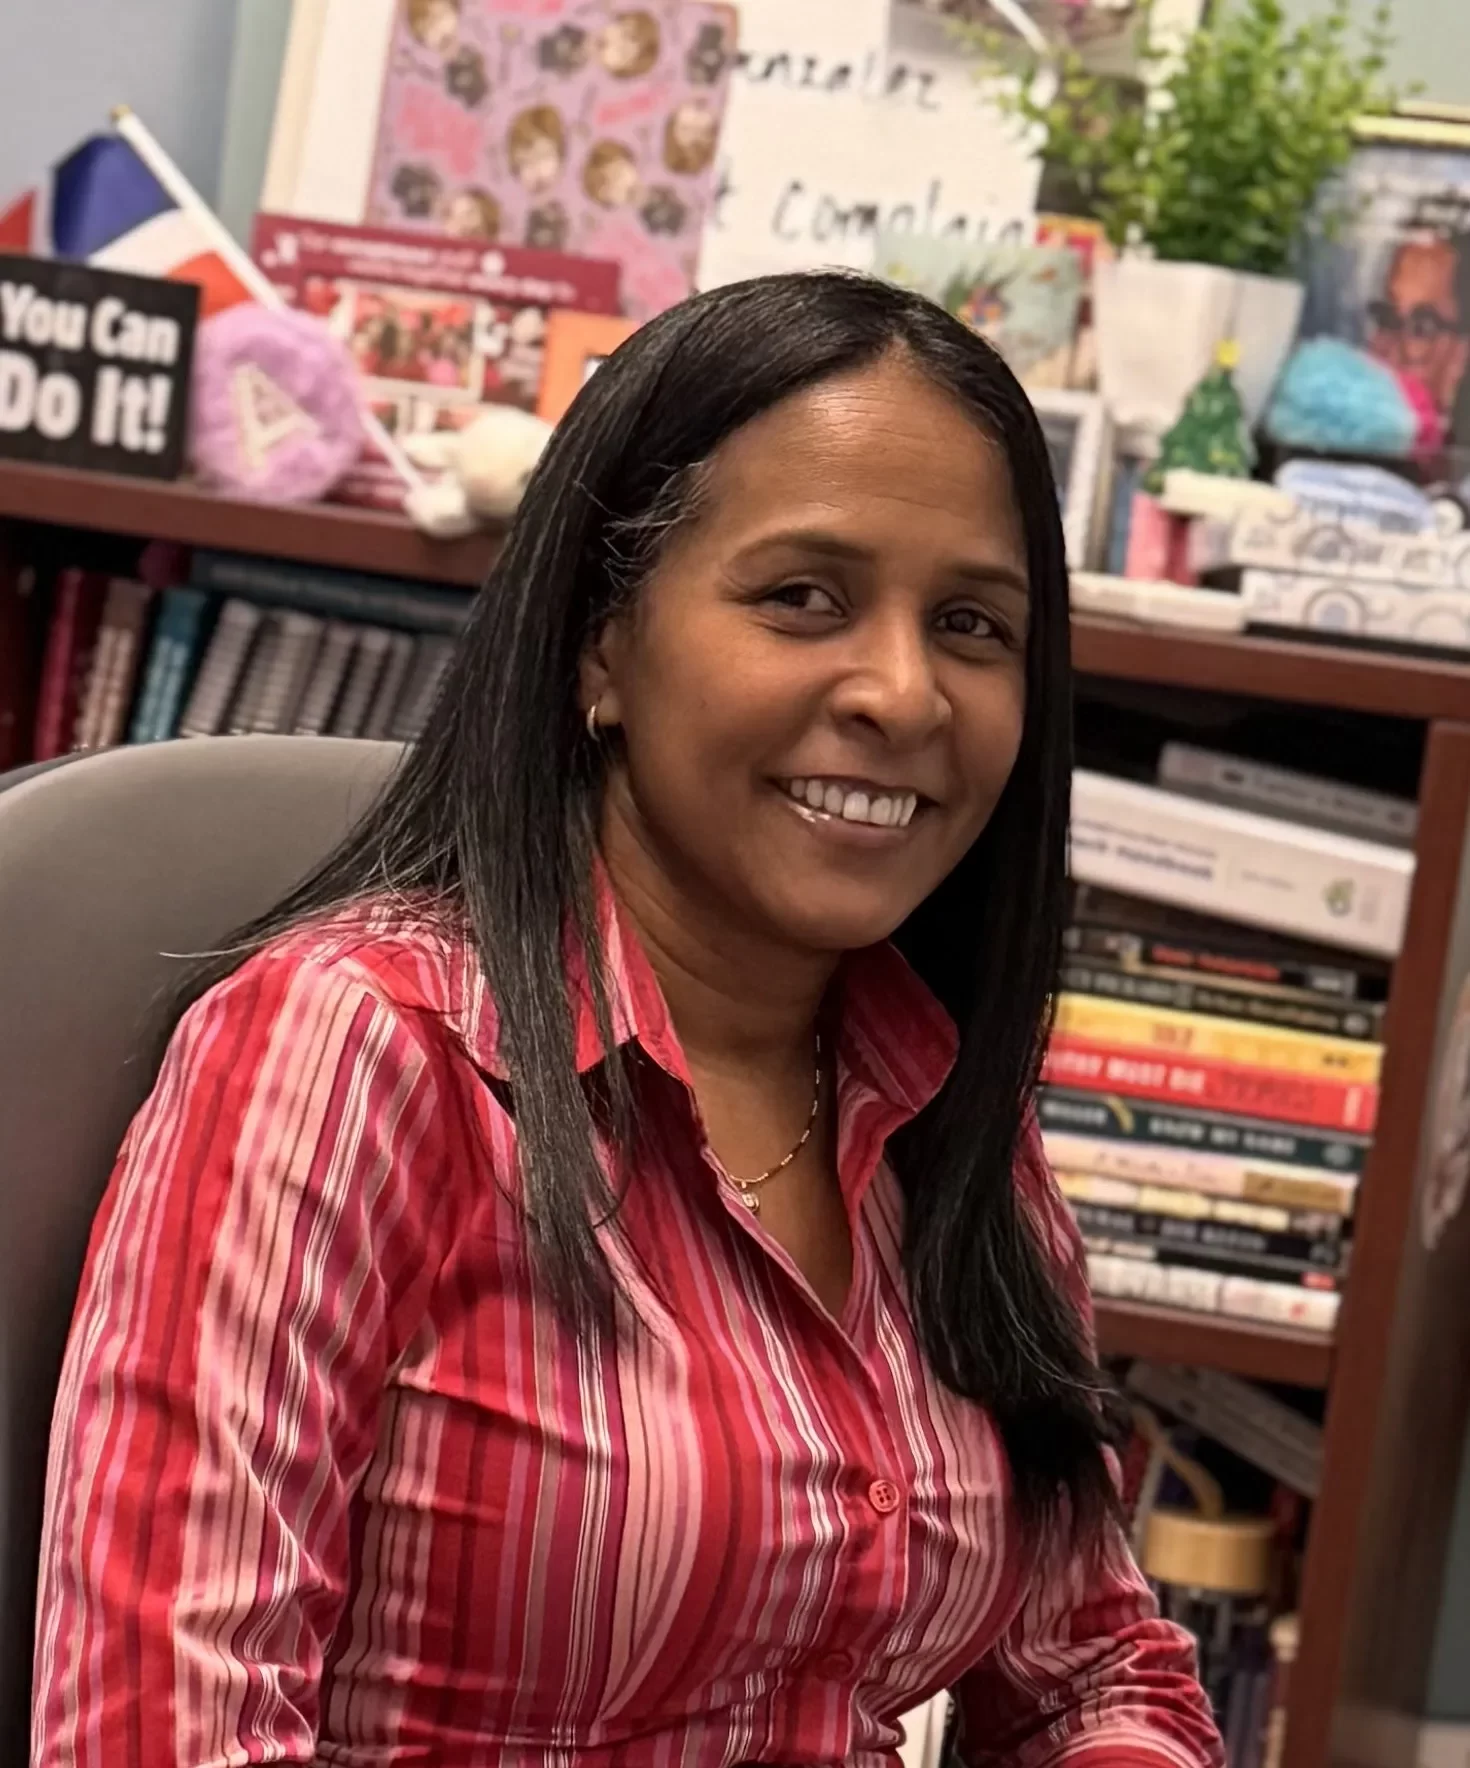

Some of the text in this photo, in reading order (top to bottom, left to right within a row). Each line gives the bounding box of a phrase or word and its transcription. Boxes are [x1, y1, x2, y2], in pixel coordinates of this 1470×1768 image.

[0, 281, 181, 366] You Can
[0, 351, 172, 453] Do It!
